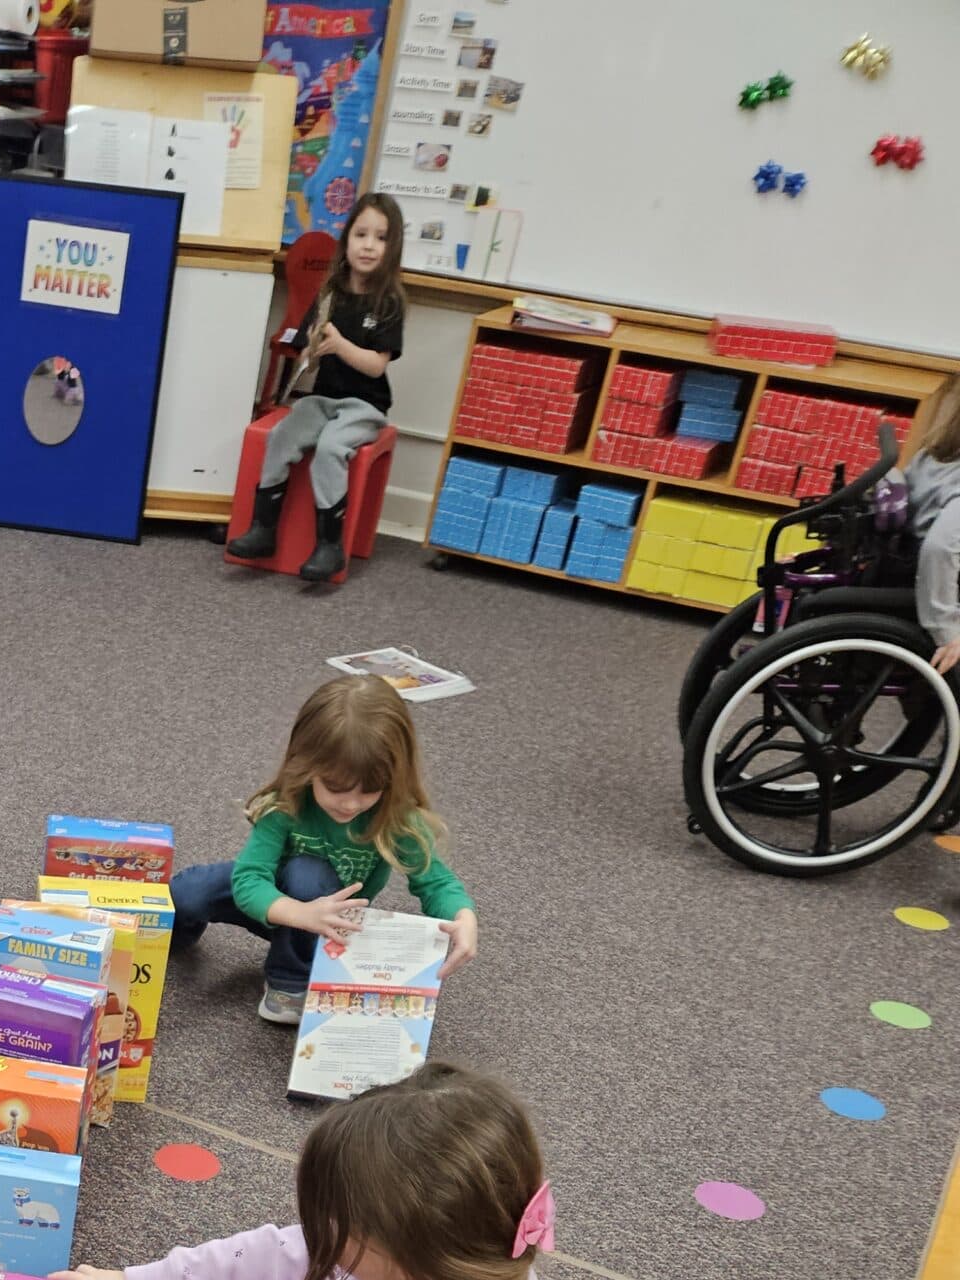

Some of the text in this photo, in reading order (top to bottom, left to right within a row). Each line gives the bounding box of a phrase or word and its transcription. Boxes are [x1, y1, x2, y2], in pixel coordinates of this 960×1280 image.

[56, 237, 98, 267] YOU
[32, 264, 112, 299] MATTER
[97, 896, 139, 905] Cheerios
[7, 937, 87, 967] FAMILY SIZE
[8, 1035, 53, 1053] GRAIN?
